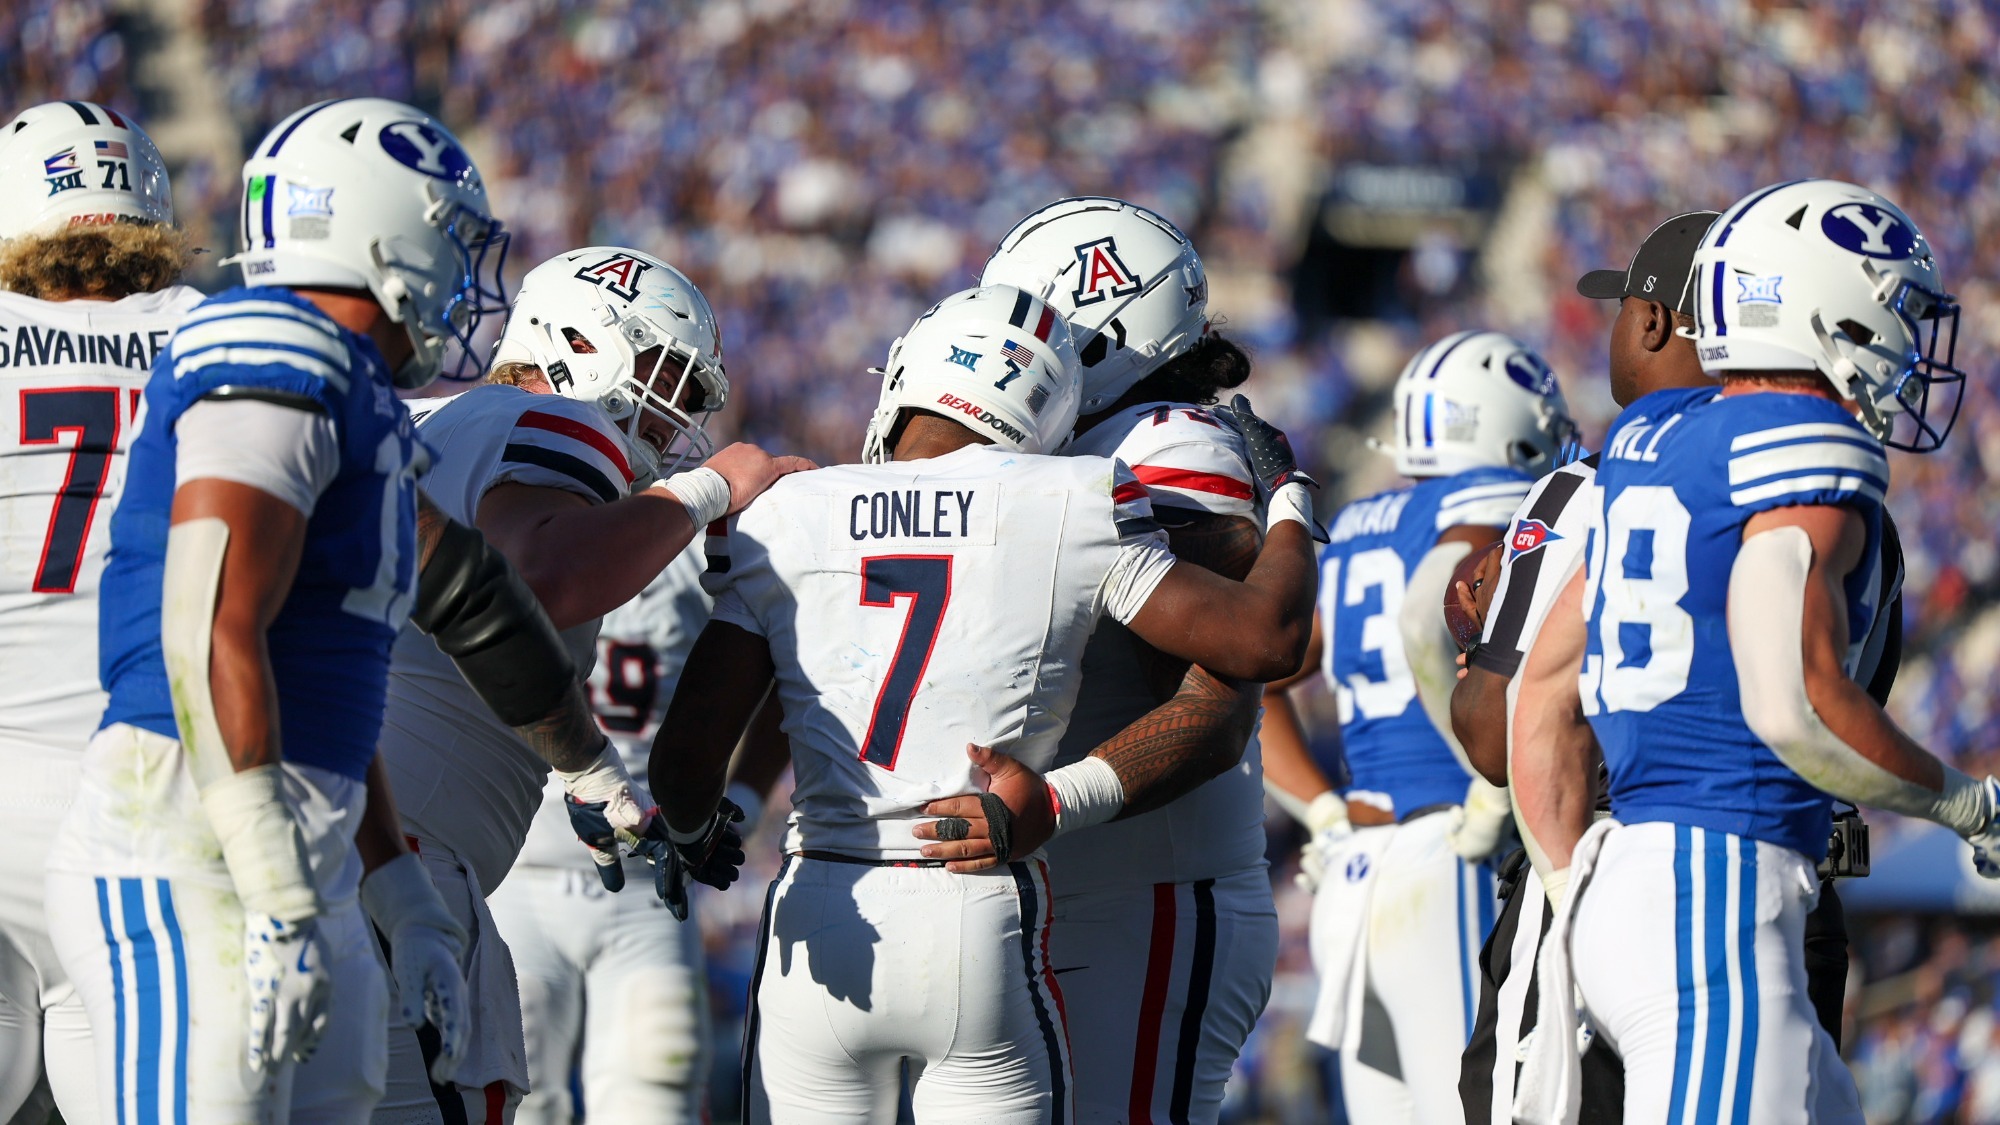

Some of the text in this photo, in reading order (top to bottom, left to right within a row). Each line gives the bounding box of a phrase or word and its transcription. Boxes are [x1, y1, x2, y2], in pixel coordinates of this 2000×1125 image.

[389, 123, 449, 175] Y
[44, 169, 87, 197] XII
[97, 160, 132, 191] 71
[1831, 203, 1900, 255] Y
[574, 252, 653, 303] A
[1072, 236, 1143, 309] A
[1643, 275, 1657, 293] S
[944, 344, 984, 373] XII
[994, 358, 1022, 391] 7
[19, 386, 143, 593] 7
[850, 490, 975, 541] CONLEY
[1516, 533, 1536, 547] CFO
[1320, 546, 1418, 725] 13
[586, 640, 661, 736] 9
[857, 554, 953, 771] 7
